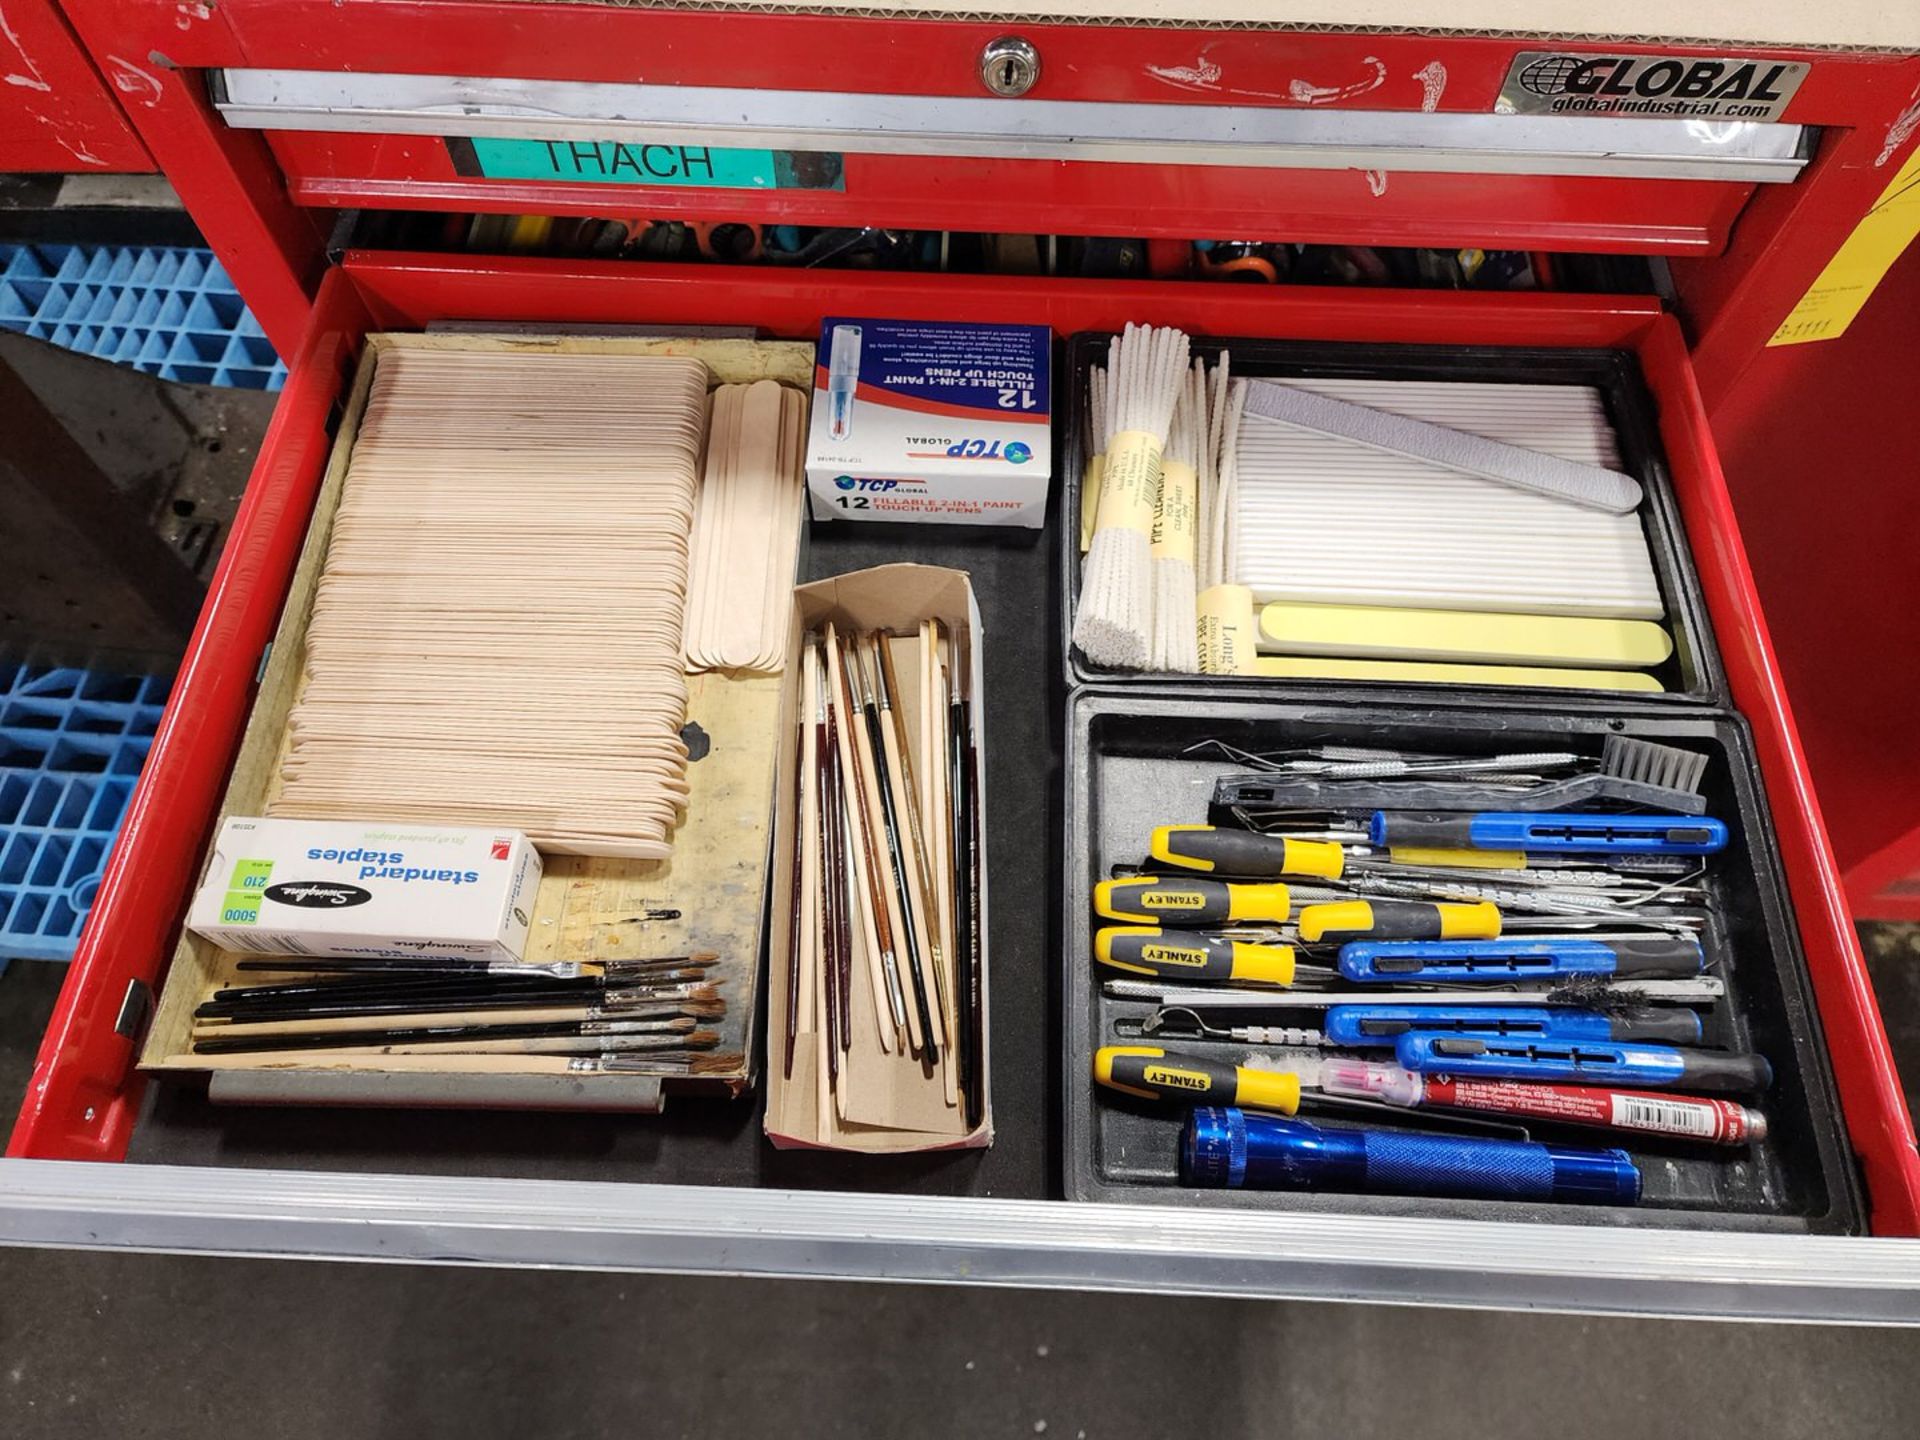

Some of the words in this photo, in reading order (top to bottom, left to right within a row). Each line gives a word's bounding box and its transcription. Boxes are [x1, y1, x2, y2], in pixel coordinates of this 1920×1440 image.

[1563, 58, 1787, 102] GLOBAL
[1551, 96, 1771, 119] globalindustrial.com
[534, 139, 714, 179] THACH
[924, 368, 962, 377] PENS
[964, 370, 984, 378] UP
[987, 370, 1035, 381] TOUCH
[883, 375, 925, 385] PAINT
[929, 377, 967, 387] 2-IN-1
[970, 378, 1035, 390] FILLABLE
[997, 388, 1037, 409] 12
[905, 437, 952, 445] GLOBAL
[946, 439, 1001, 459] TCP
[857, 479, 898, 492] TCP
[835, 496, 870, 509] 12
[873, 497, 936, 507] FILLABLE
[940, 499, 978, 508] 2-IN-1
[982, 501, 1024, 509] PAINT
[874, 504, 922, 512] TOUCH
[946, 506, 982, 514] PENS
[1219, 625, 1238, 675] Long's
[306, 847, 405, 866] staples
[243, 875, 267, 887] 210
[358, 866, 479, 885] standard
[280, 884, 357, 905] Swingline
[1146, 894, 1201, 907] STANLEY
[224, 909, 257, 922] 5000
[392, 940, 491, 954] Swingline
[1147, 948, 1203, 965] STANLEY
[1148, 1072, 1208, 1089] STANLEY
